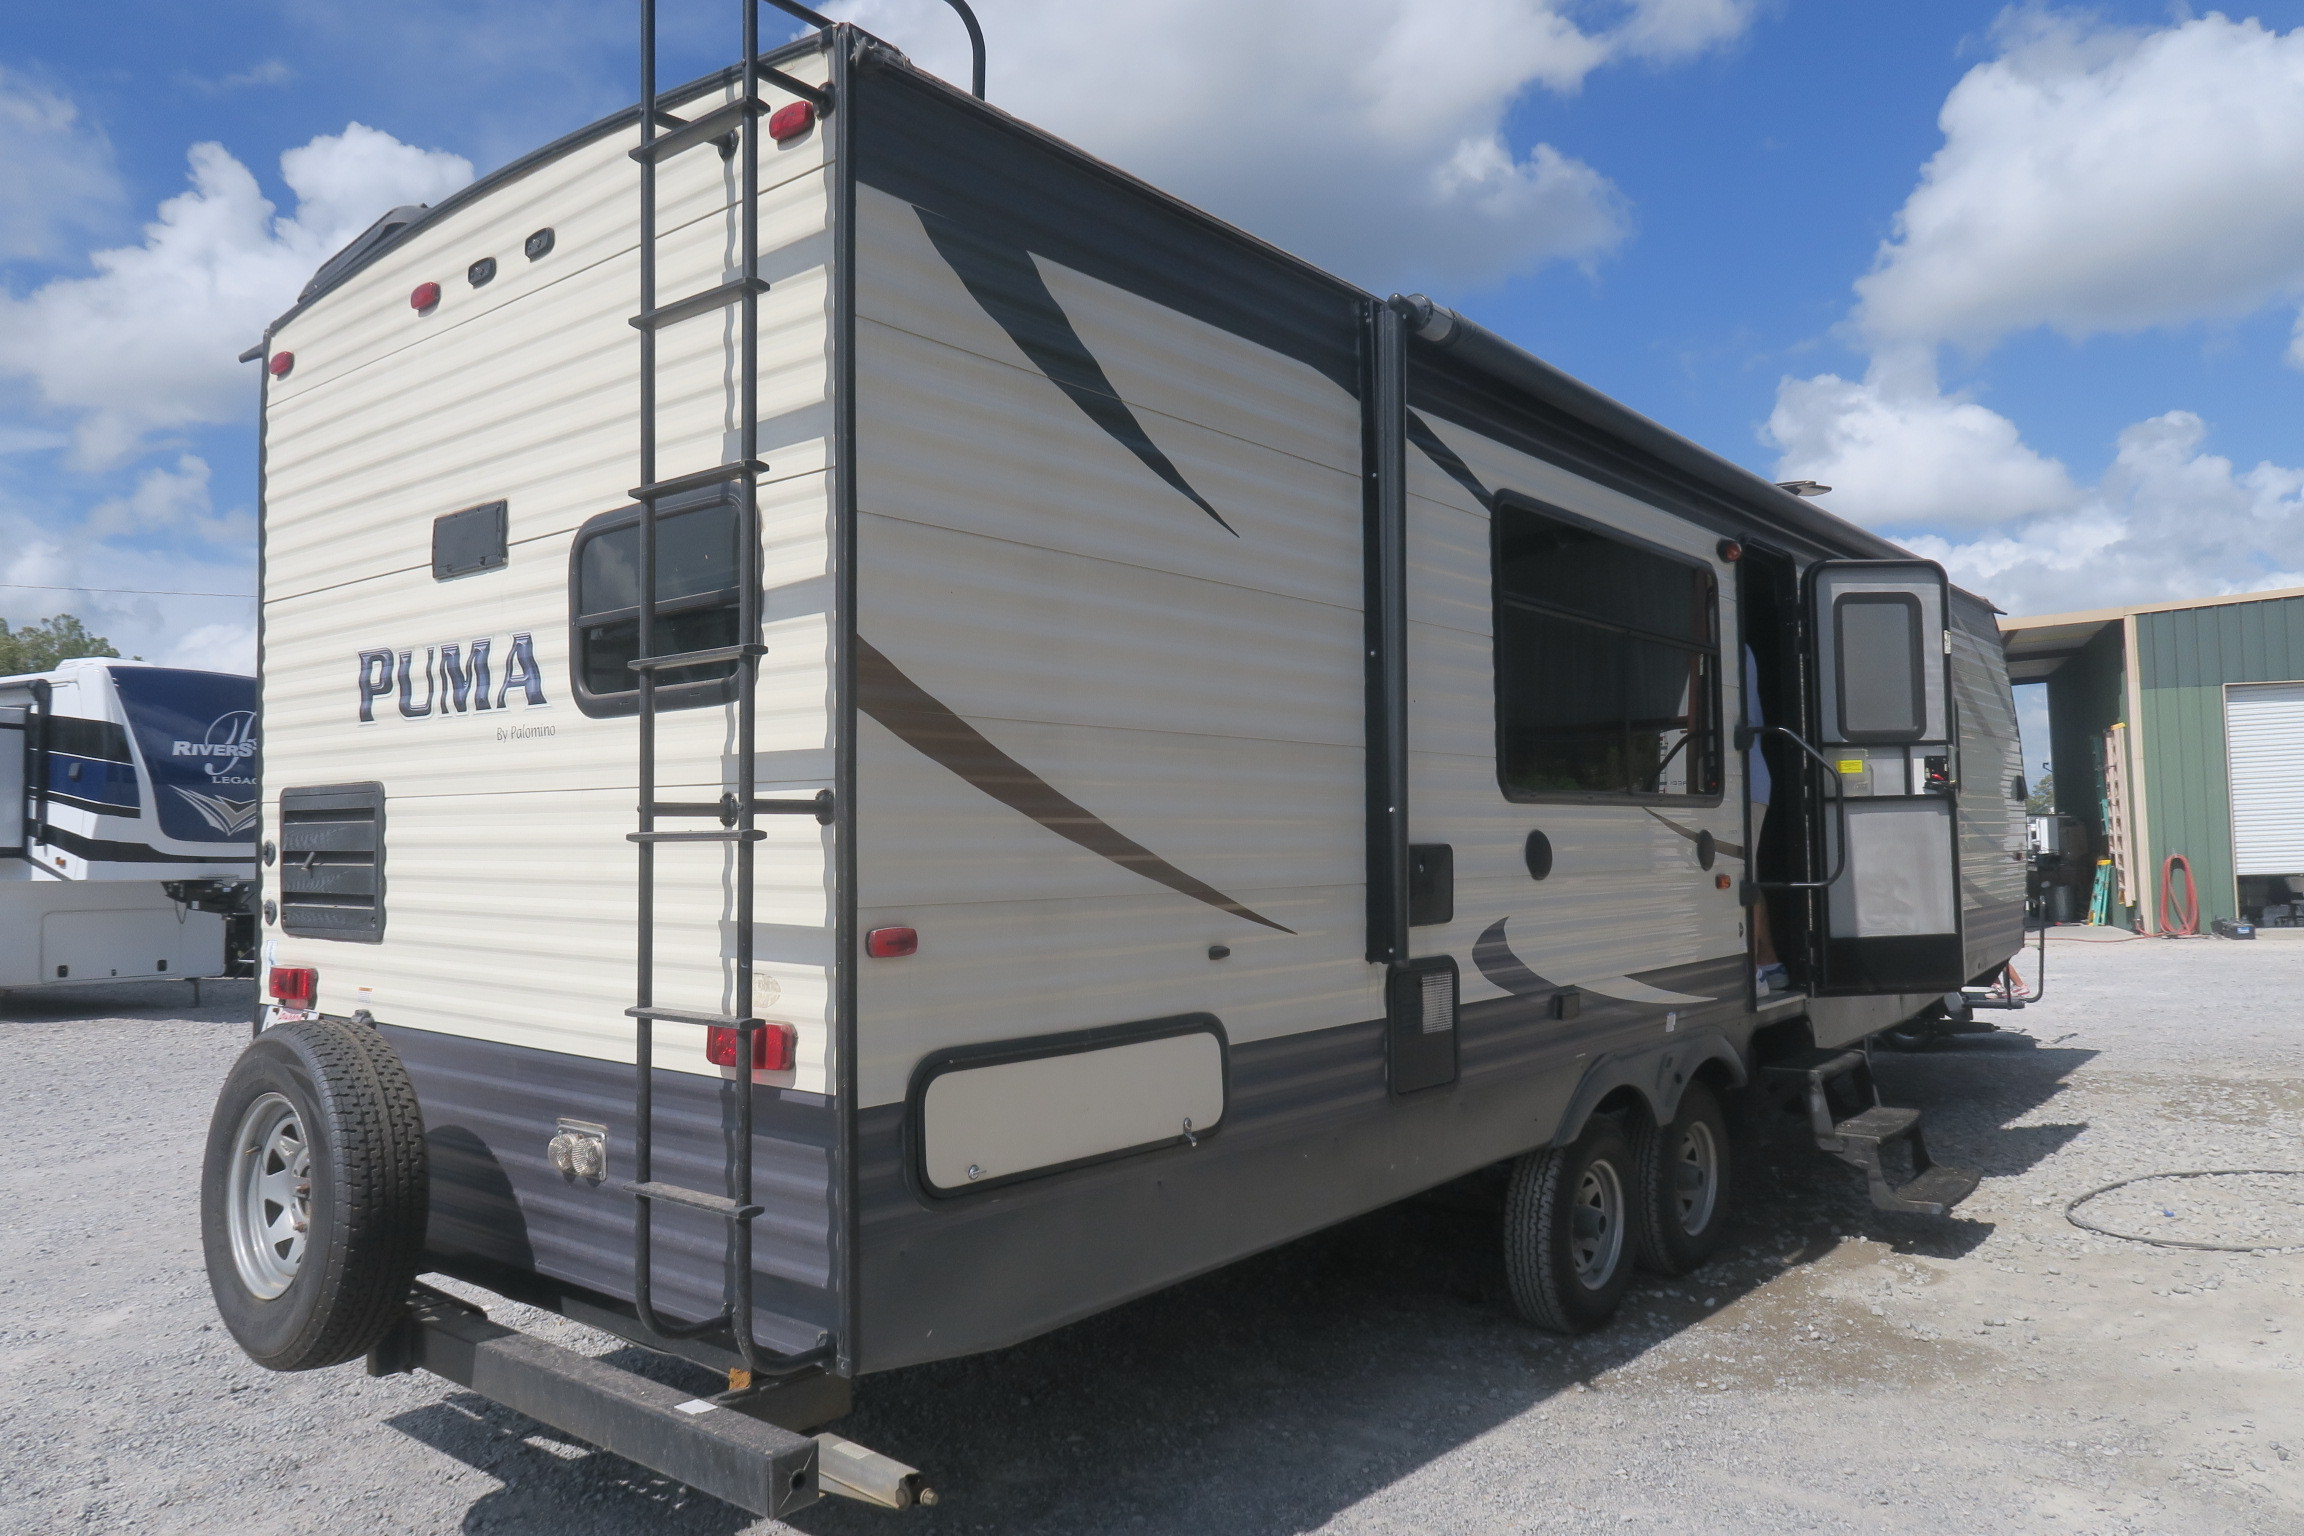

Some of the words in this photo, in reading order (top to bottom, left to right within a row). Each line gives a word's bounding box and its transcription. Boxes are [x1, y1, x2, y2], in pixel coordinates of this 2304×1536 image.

[357, 631, 550, 724] PUMA
[496, 727, 508, 743] By
[510, 723, 556, 739] Palomino
[172, 740, 257, 757] RIVERS
